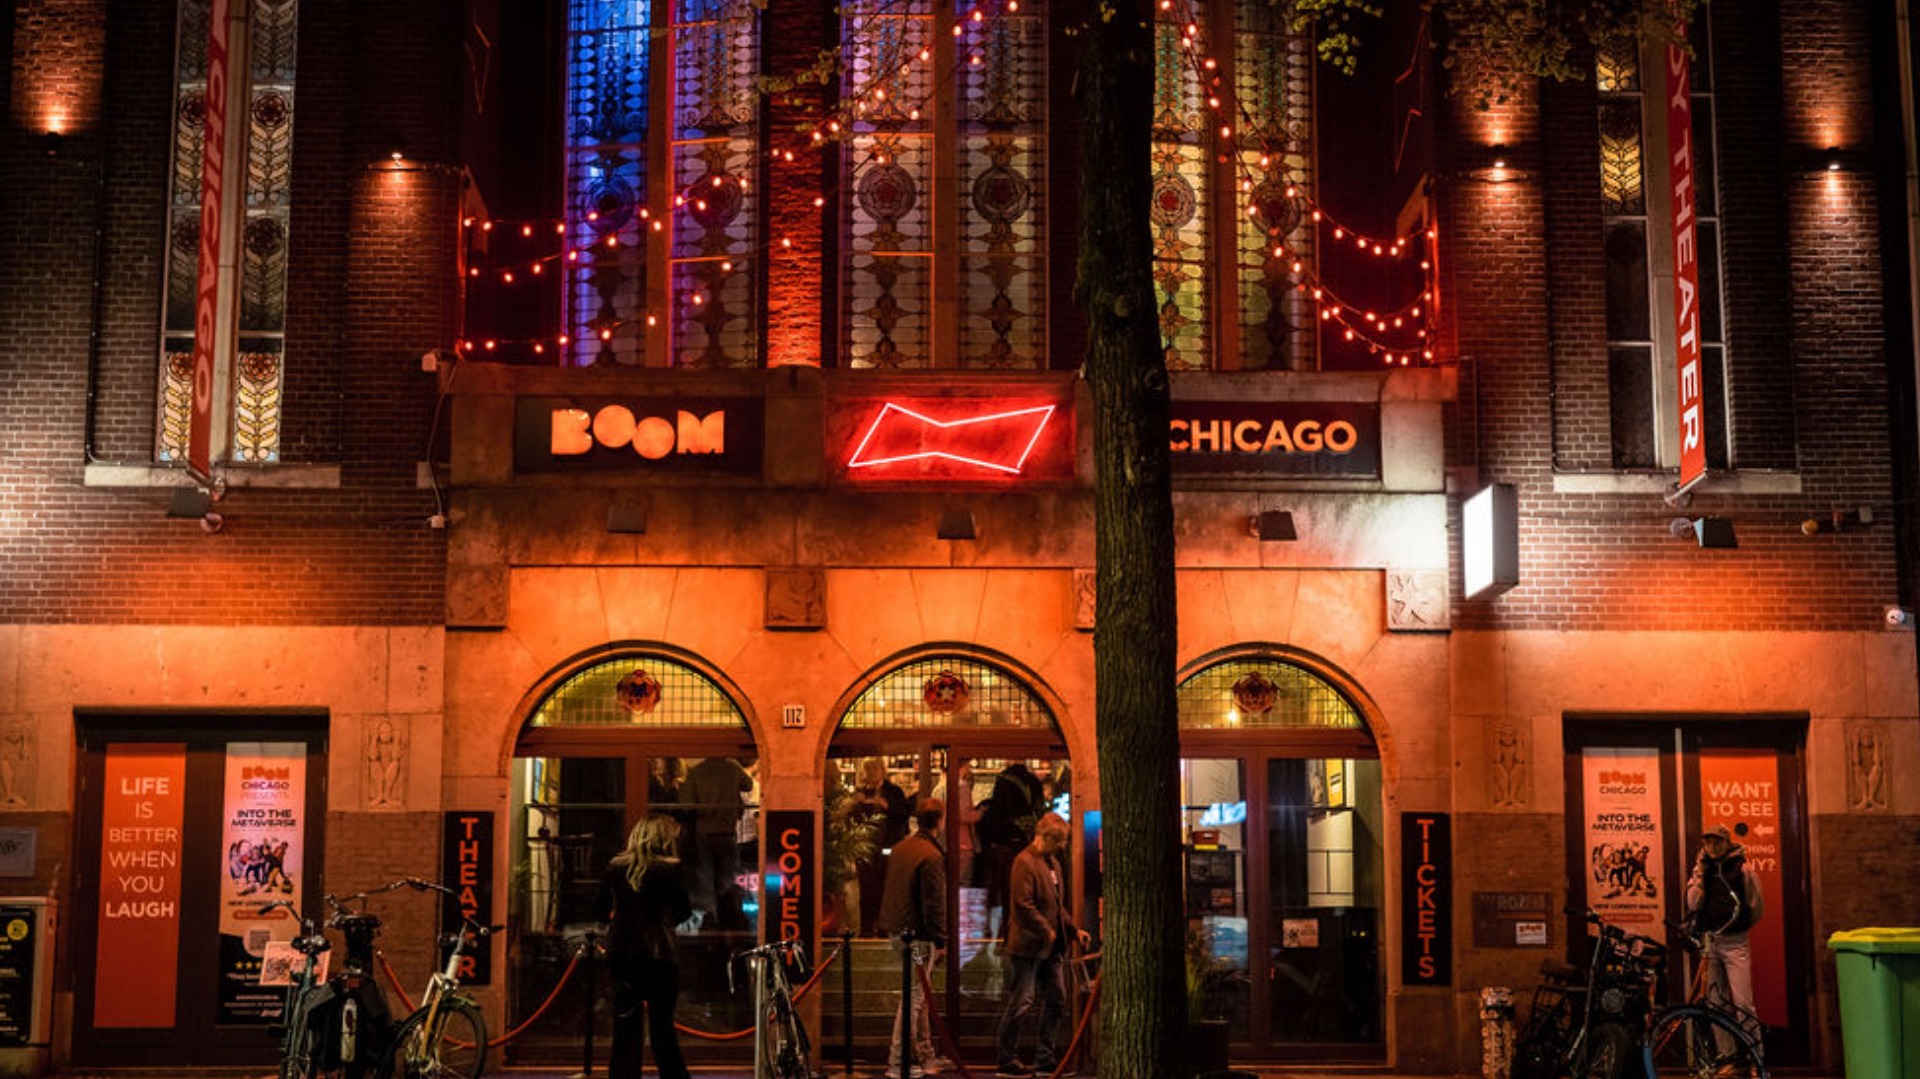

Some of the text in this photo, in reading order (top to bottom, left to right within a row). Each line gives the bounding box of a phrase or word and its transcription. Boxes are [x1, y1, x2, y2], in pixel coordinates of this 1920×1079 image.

[196, 58, 226, 414] CHICAGO
[1673, 127, 1698, 453] THEATER
[551, 404, 725, 460] BOOM
[1170, 420, 1358, 452] CHICAGO
[121, 777, 170, 795] LIFE
[242, 781, 290, 790] CHICAGO
[1599, 786, 1647, 795] CHICAGO
[1708, 782, 1773, 798] WANT
[135, 801, 154, 819] IS
[237, 809, 292, 818] INTO THE
[1597, 813, 1651, 822] INTO THE
[1708, 802, 1774, 816] TO SEE
[231, 819, 296, 827] METAVERSE
[1592, 823, 1655, 831] METAVERSE
[109, 827, 178, 842] BETTER
[108, 851, 176, 868] WHEN
[118, 876, 165, 893] YOU
[1417, 819, 1436, 978] TICKETS
[105, 901, 175, 918] LAUGH
